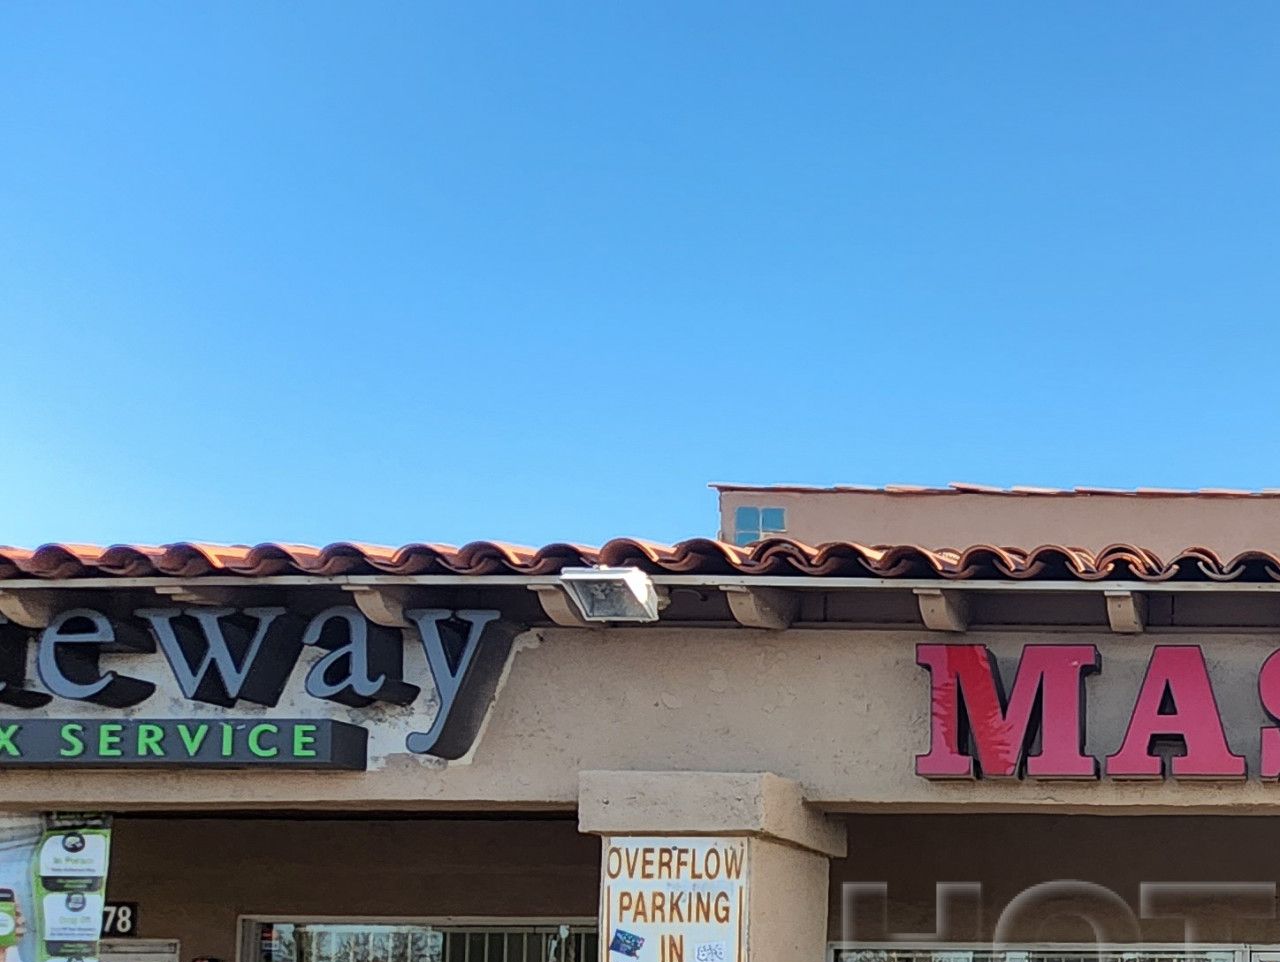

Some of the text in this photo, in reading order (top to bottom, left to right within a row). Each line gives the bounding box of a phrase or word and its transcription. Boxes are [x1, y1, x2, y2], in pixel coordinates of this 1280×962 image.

[0, 606, 500, 754] eway
[60, 723, 318, 757] SERVICE
[607, 846, 744, 879] OVERFLOW
[619, 891, 730, 923] PARKING
